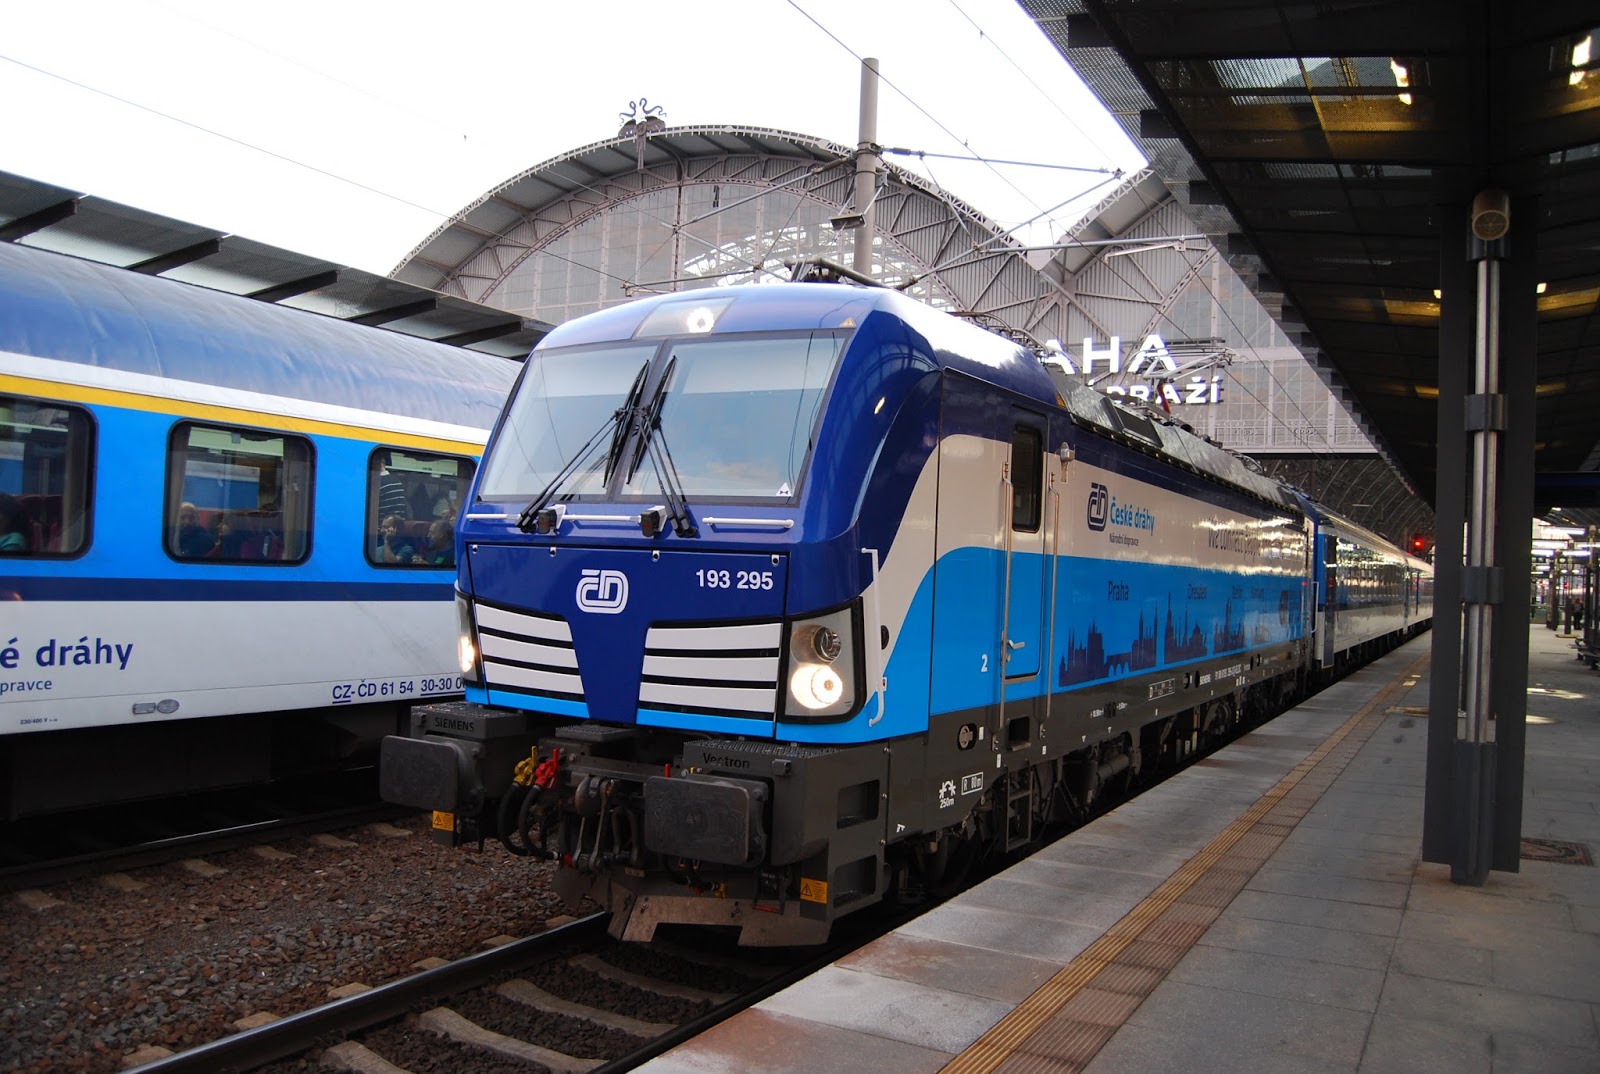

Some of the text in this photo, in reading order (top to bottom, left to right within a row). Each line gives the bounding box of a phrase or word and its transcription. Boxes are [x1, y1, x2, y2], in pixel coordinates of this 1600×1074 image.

[1110, 496, 1155, 536] České dráhy
[696, 569, 774, 590] 193 295
[1108, 580, 1129, 601] Praha
[36, 636, 134, 671] dráhy
[981, 654, 988, 672] 2
[0, 680, 53, 696] pravce
[381, 682, 394, 696] 61
[399, 681, 414, 694] 54
[420, 677, 452, 692] 30-30
[434, 717, 475, 733] SIEMENS
[703, 752, 750, 769] Vectron
[963, 778, 968, 792] R
[939, 797, 955, 809] 250m
